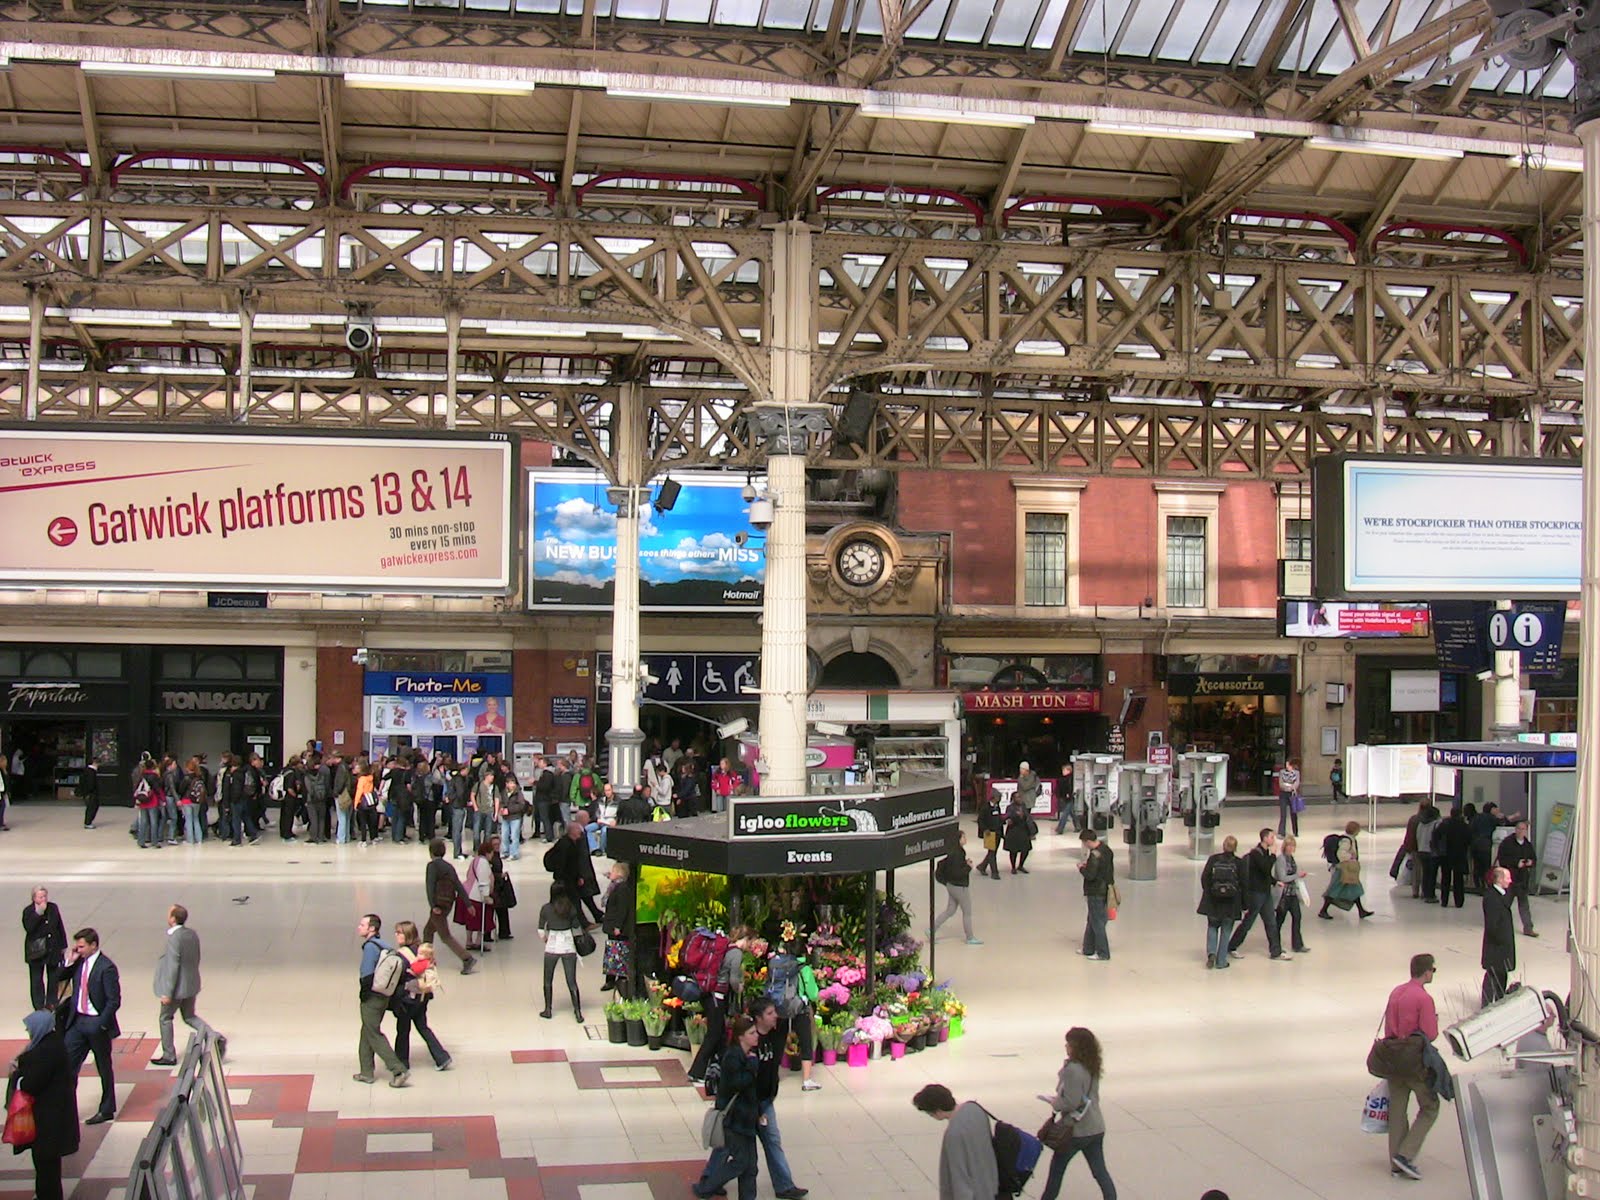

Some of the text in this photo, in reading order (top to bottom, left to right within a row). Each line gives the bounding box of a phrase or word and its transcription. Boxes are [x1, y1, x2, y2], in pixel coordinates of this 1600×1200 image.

[88, 465, 473, 546] Gatwick platforms 13 & 14
[389, 520, 475, 540] 30 mins non-stop
[1363, 517, 1394, 527] WE'RE
[1396, 518, 1466, 528] STOCKPICKIER
[1468, 519, 1494, 529] THAN
[1495, 520, 1528, 530] OTHER
[410, 534, 477, 551] every 15 mins
[380, 547, 479, 569] gatwickexpress.com
[546, 546, 586, 559] NEW
[660, 549, 686, 560] things
[687, 550, 716, 559] others
[719, 547, 759, 563] MISS
[215, 597, 260, 607] JCDecaux
[723, 590, 760, 600] Hotmail
[395, 676, 482, 693] Photo-Me
[1195, 675, 1265, 694] Accessorize
[162, 691, 271, 710] TONI&GUY
[414, 696, 480, 704] PASSPORT PHOTOS
[975, 695, 1023, 708] MASH
[1030, 695, 1067, 708] TUN
[1444, 751, 1535, 766] Rail information
[740, 814, 849, 833] iglooflowers
[892, 808, 946, 830] iglooflowers.com
[639, 843, 689, 860] weddings
[905, 839, 945, 856] fresh flowers
[787, 850, 833, 863] Events
